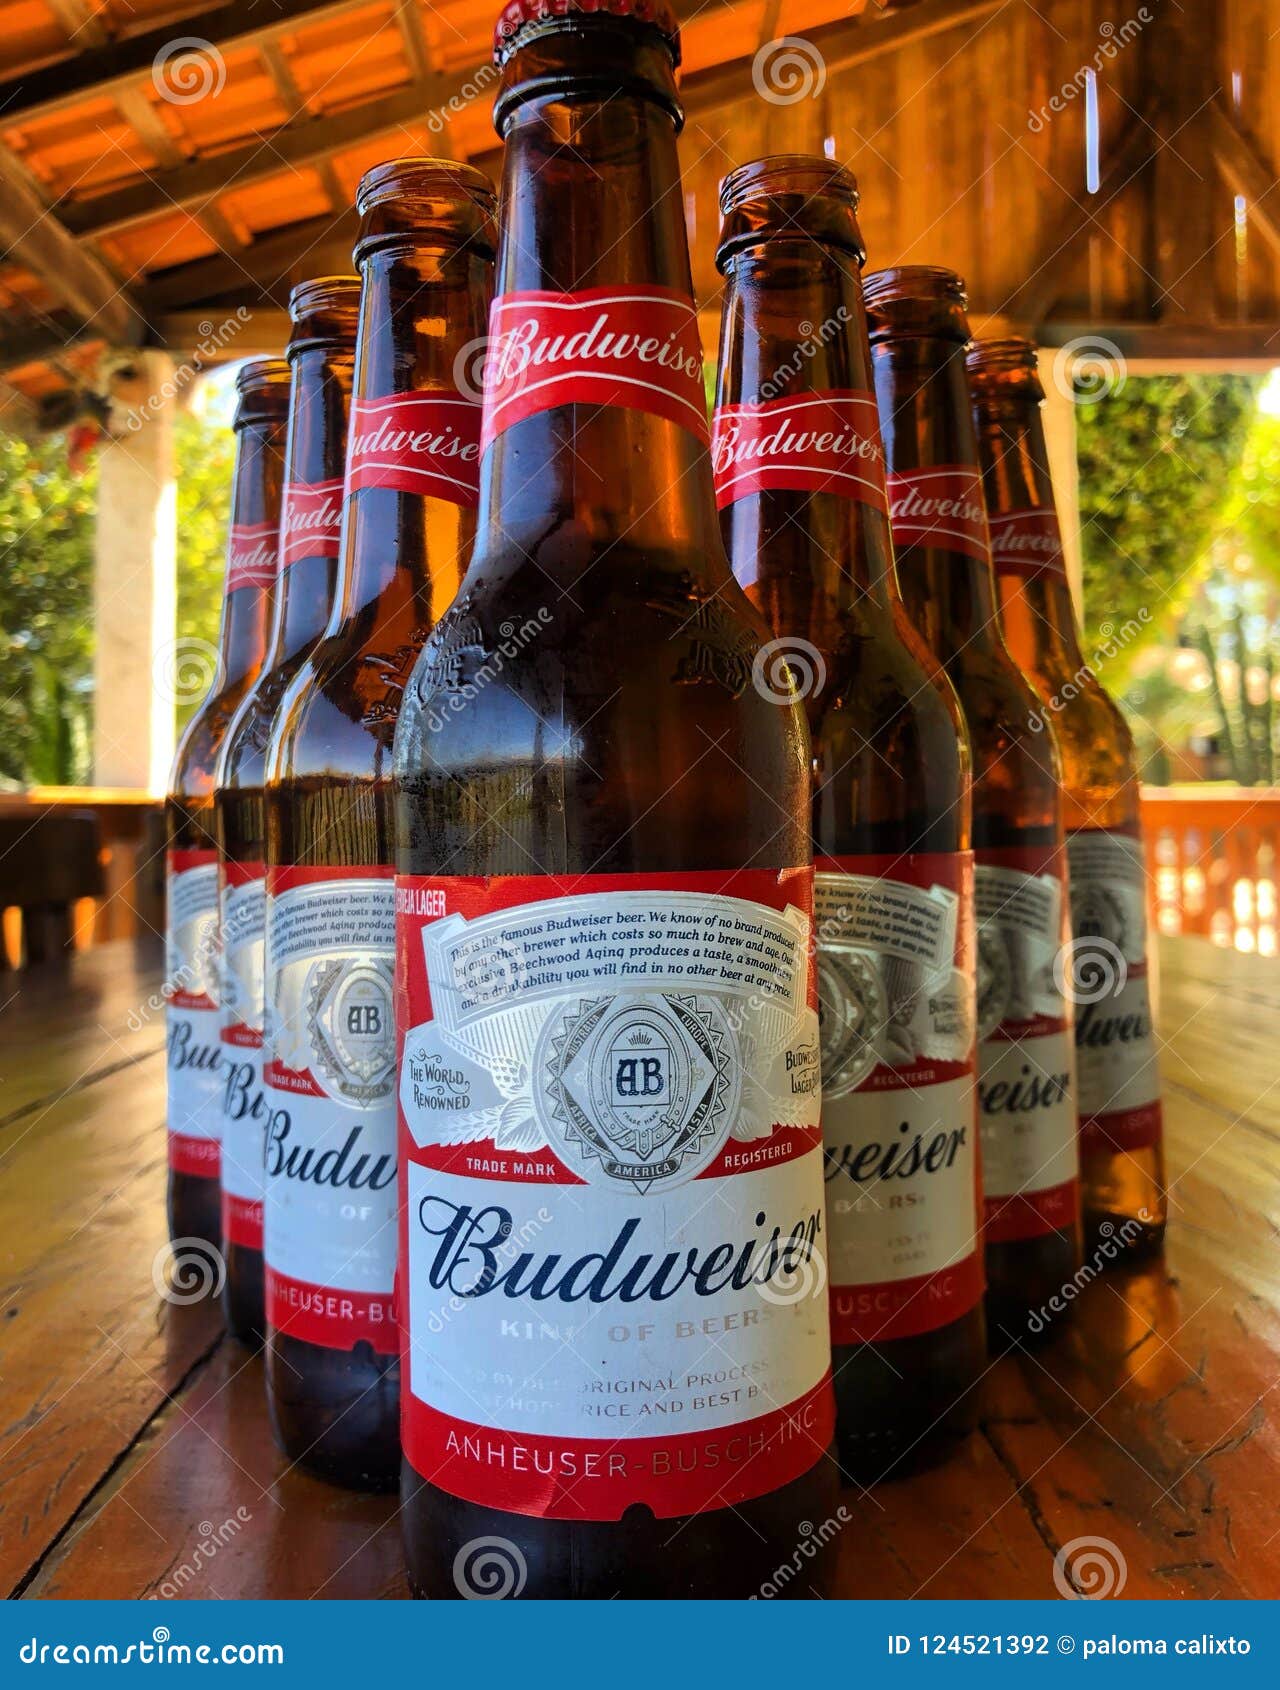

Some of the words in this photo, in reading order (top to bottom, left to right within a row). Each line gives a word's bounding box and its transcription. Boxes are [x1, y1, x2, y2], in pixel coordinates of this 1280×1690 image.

[416, 889, 446, 917] LAGER
[451, 944, 470, 962] This
[470, 941, 481, 953] is
[482, 935, 498, 949] the
[499, 924, 544, 942] famous
[546, 914, 613, 932] Budweiser
[616, 912, 646, 925] beer.
[649, 911, 668, 923] We
[670, 911, 701, 924] know
[704, 915, 719, 928] of
[718, 918, 733, 928] no
[734, 920, 763, 936] brand
[763, 928, 796, 950] produced
[454, 965, 468, 978] by
[468, 959, 488, 973] any
[490, 947, 521, 963] other
[523, 937, 567, 954] brewer
[569, 930, 608, 945] which
[611, 928, 644, 940] costs
[648, 929, 663, 939] so
[666, 929, 700, 941] much
[703, 931, 715, 942] to
[717, 933, 744, 947] brew
[745, 938, 765, 951] and
[765, 947, 781, 961] age.
[781, 952, 793, 966] Our
[457, 967, 505, 994] exclusive
[509, 950, 581, 975] Beechwood
[585, 946, 625, 959] Aging
[629, 944, 689, 957] produces
[692, 949, 701, 958] a
[703, 947, 734, 963] taste,
[737, 954, 744, 964] a
[491, 969, 562, 997] drinkability
[566, 967, 589, 981] you
[593, 962, 618, 976] will
[620, 962, 647, 976] find
[651, 962, 663, 974] in
[667, 965, 683, 974] no
[686, 964, 718, 977] other
[720, 966, 743, 981] beer
[744, 972, 756, 984] at
[756, 977, 772, 992] any
[772, 983, 793, 1000] price.
[347, 1005, 382, 1035] AB
[680, 1014, 709, 1049] EUROPE
[409, 1058, 424, 1082] THE
[616, 1057, 664, 1096] AB
[413, 1084, 471, 1111] RENOWNED
[569, 1103, 598, 1141] AFRICA
[686, 1103, 710, 1136] ASIA
[466, 1157, 508, 1174] TRADE
[513, 1162, 556, 1177] MARK
[613, 1162, 671, 1178] AMERICA
[724, 1141, 793, 1168] REGISTERED
[419, 1195, 822, 1303] Budweiser
[607, 1323, 656, 1343] OF
[687, 1360, 769, 1388] PROCESS
[582, 1403, 631, 1419] RICE
[638, 1400, 684, 1416] AND
[693, 1389, 741, 1410] BEST
[779, 1404, 818, 1444] INC.
